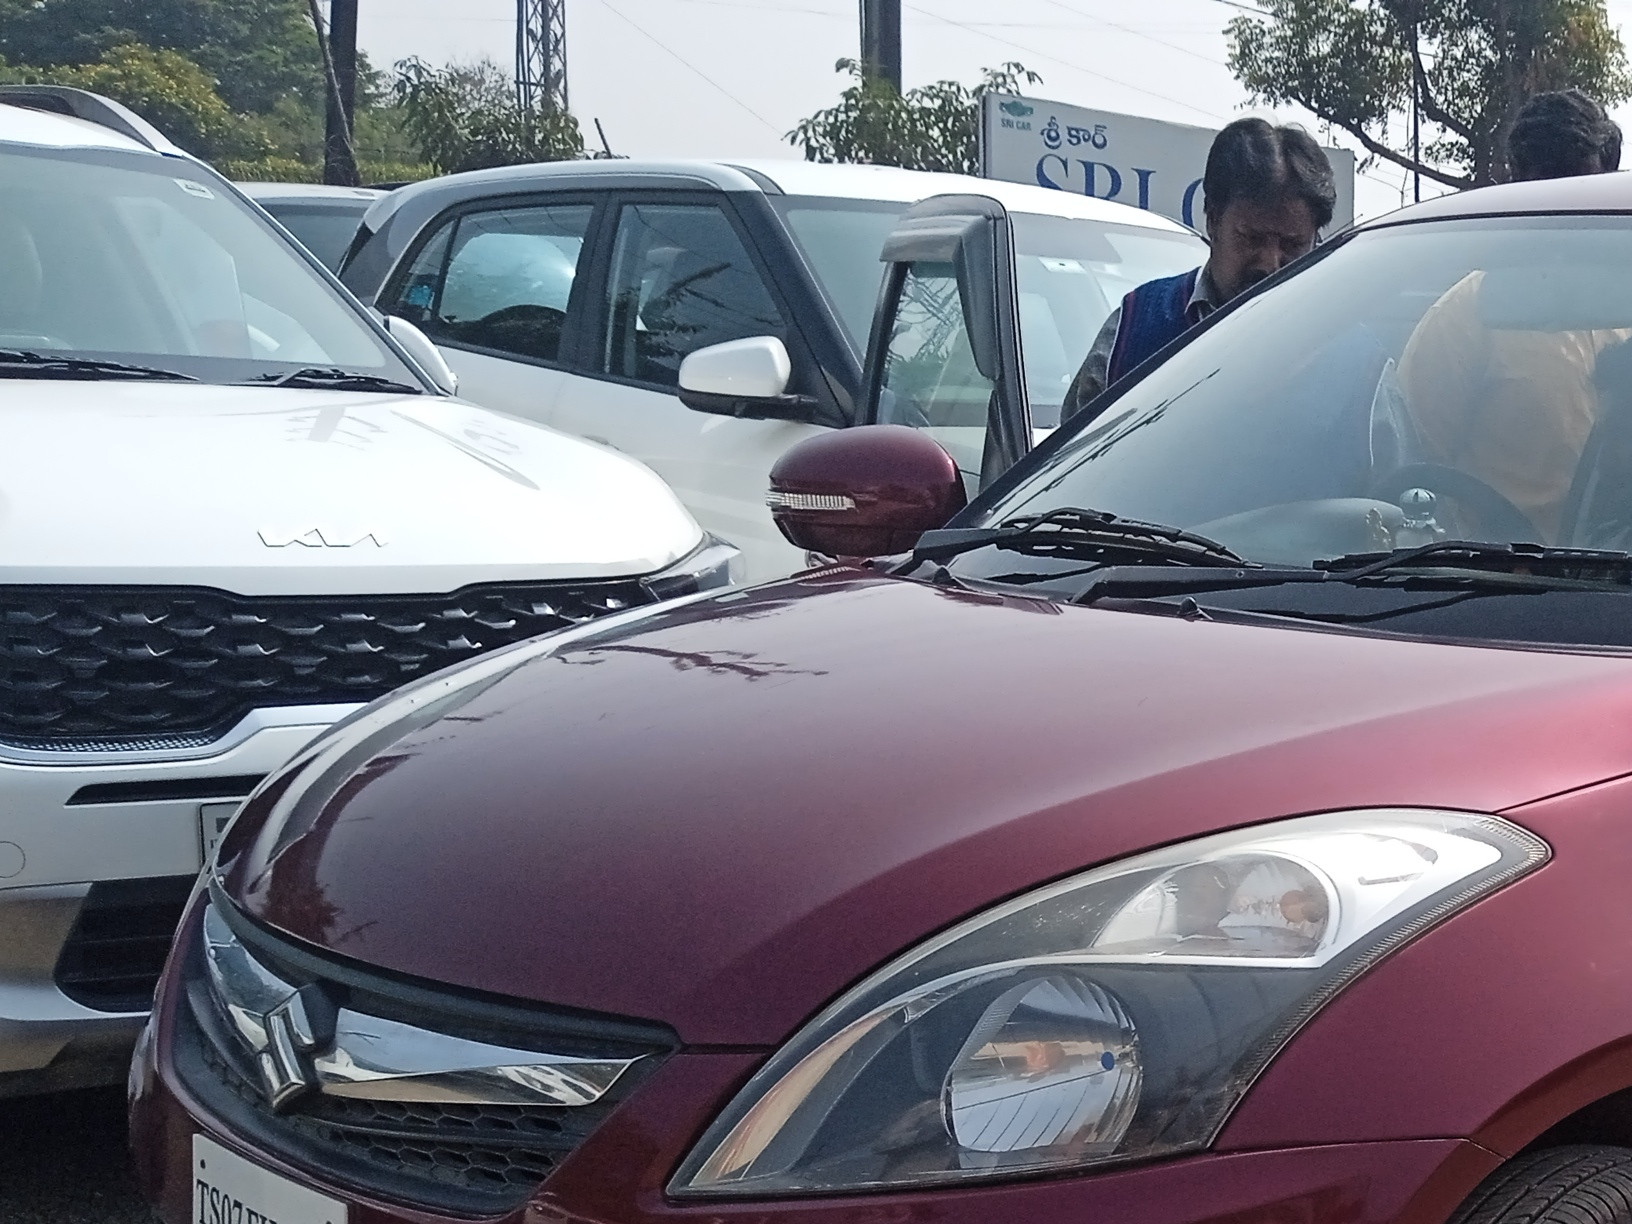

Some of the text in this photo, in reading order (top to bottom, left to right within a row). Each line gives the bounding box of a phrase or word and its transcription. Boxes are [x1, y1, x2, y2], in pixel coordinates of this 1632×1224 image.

[1000, 118, 1032, 132] SRI CAR
[1040, 115, 1108, 150] శ్రీ కార్
